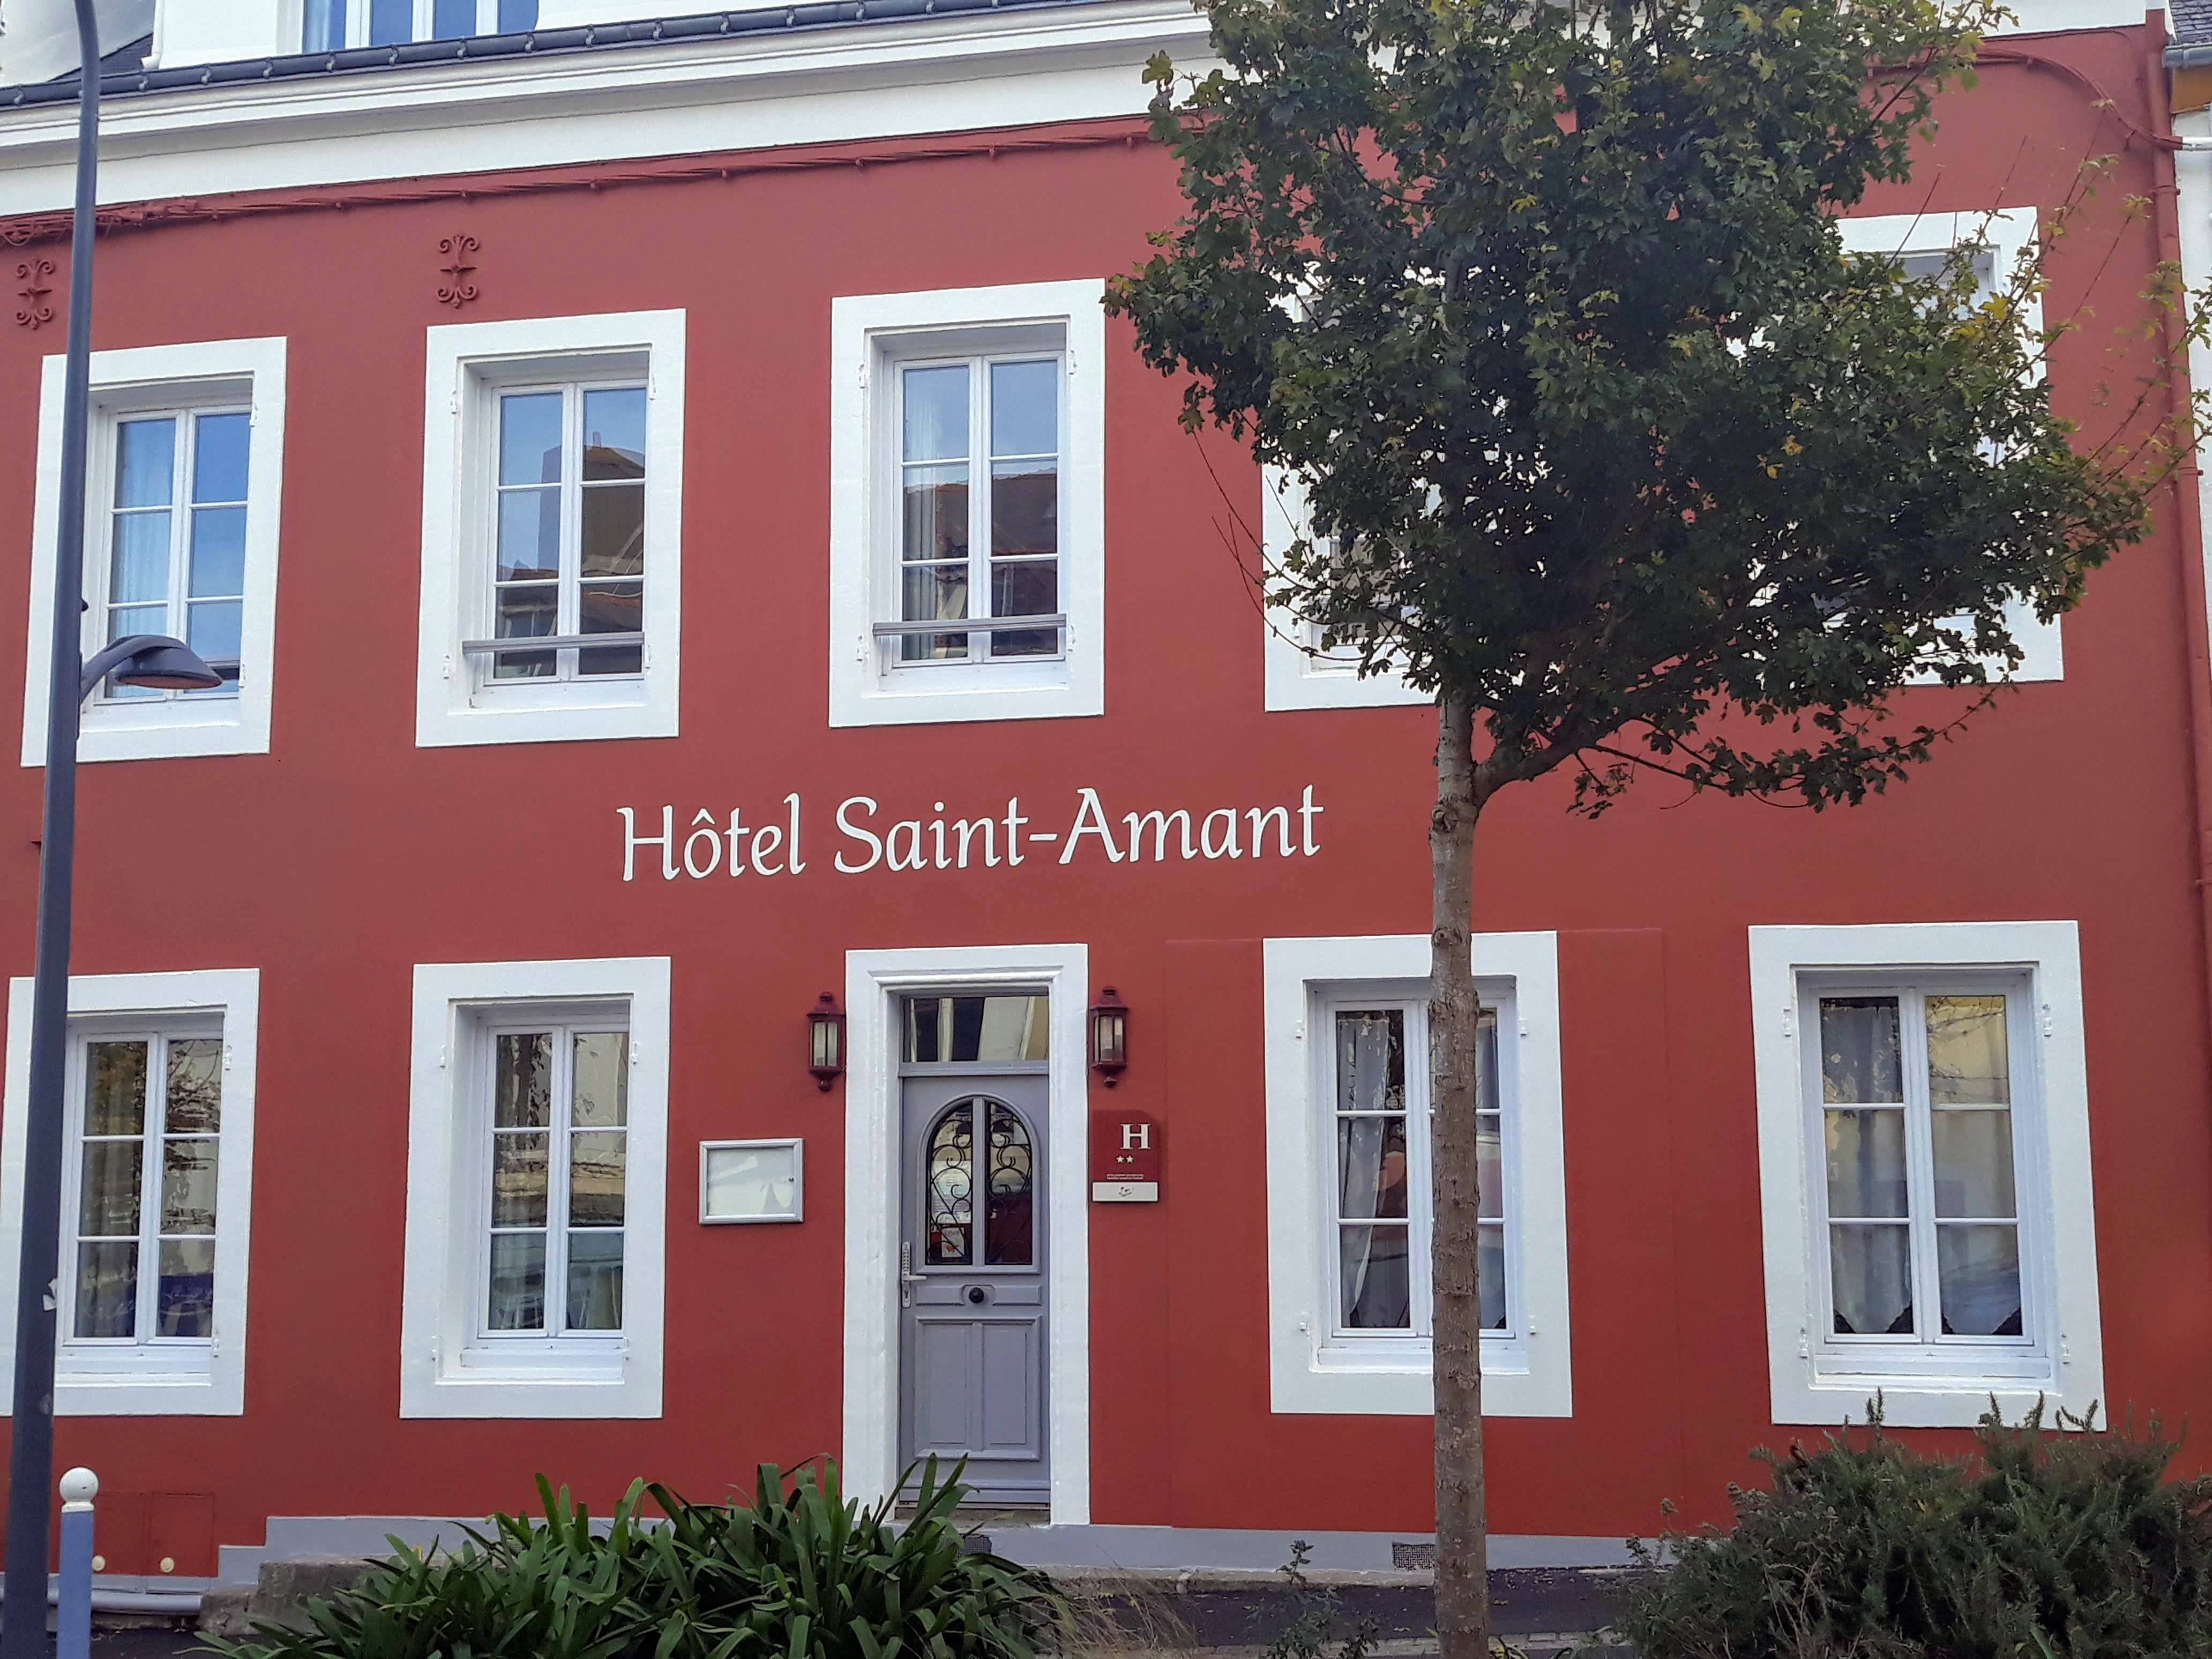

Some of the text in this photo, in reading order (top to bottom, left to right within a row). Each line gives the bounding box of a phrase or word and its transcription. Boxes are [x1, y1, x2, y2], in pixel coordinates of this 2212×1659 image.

[616, 784, 1324, 881] Hôtel Saint-Amant
[1120, 1123, 1152, 1150] H
